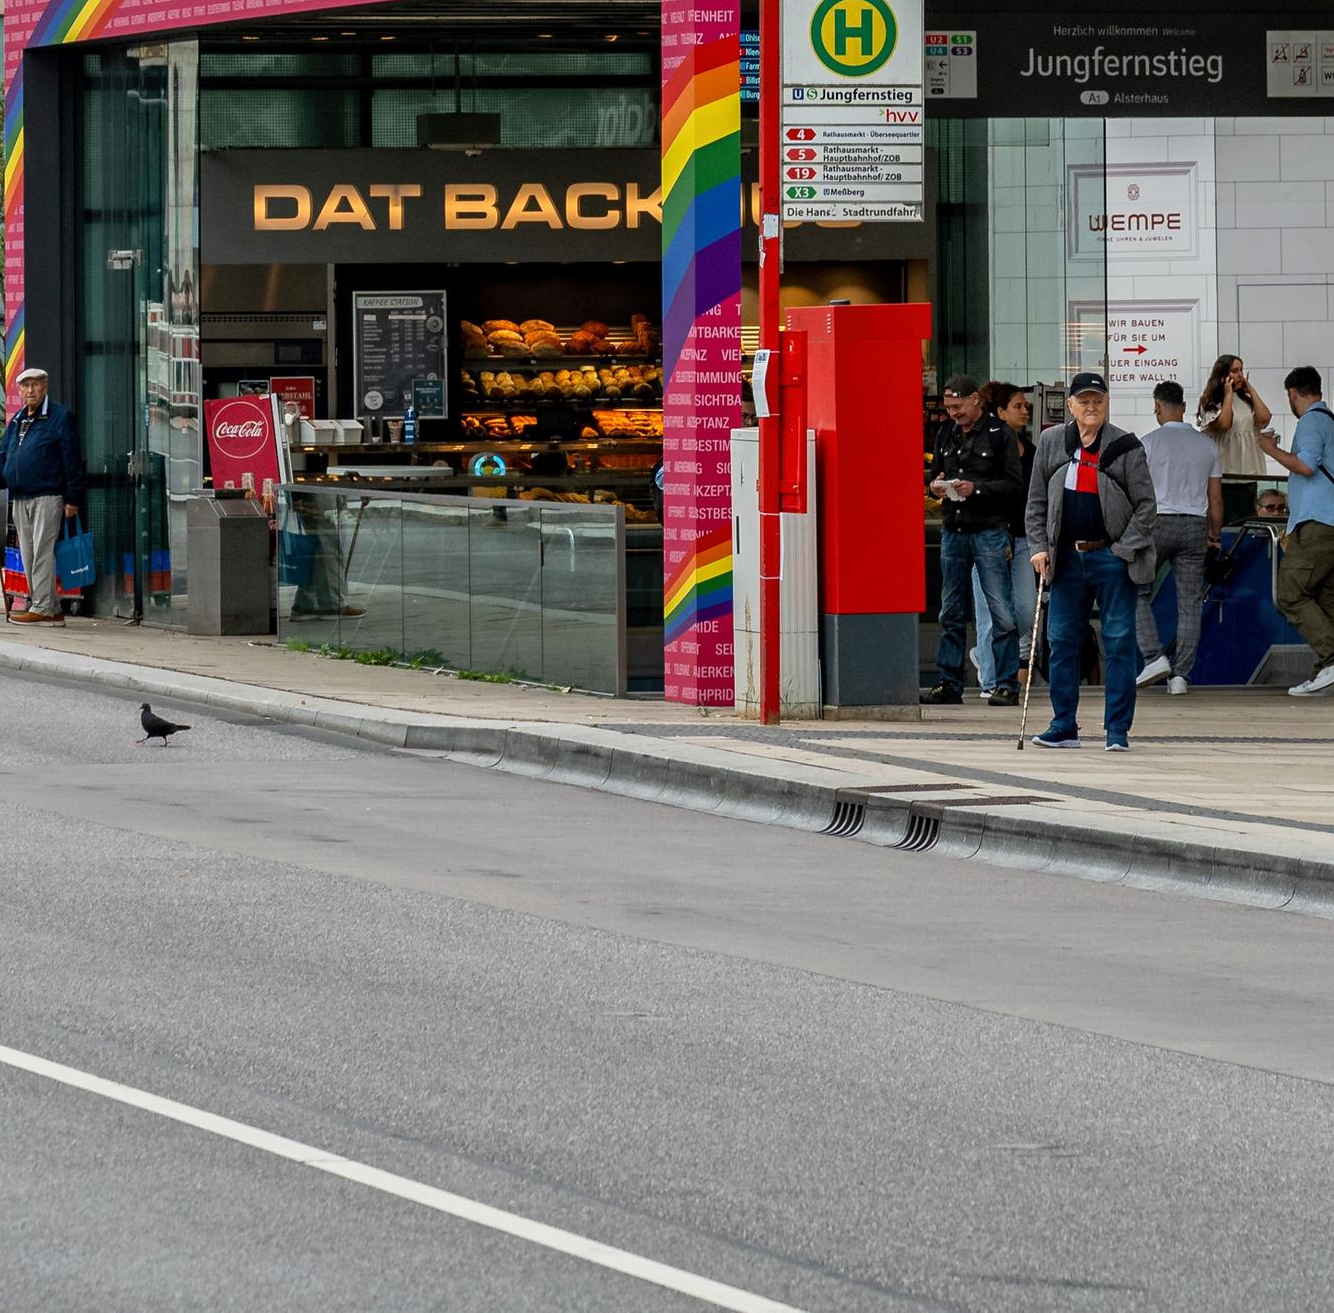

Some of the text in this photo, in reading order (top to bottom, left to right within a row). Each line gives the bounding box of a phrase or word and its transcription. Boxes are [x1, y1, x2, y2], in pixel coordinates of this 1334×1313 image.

[834, 9, 873, 55] H
[1053, 26, 1095, 36] Herzlich
[1097, 26, 1158, 36] willkommen
[1020, 46, 1223, 83] Jungfernstieg
[820, 89, 913, 103] Jungfernstieg
[1088, 93, 1169, 103] A1 Alsterhaus
[886, 109, 919, 122] hvv
[797, 130, 805, 139] 4
[870, 131, 920, 139] Überseequartier
[798, 150, 806, 159] 5
[823, 155, 901, 163] Hauptbahnhof/ZOB
[795, 169, 809, 179] 19
[795, 188, 865, 197] X3 Meßberg
[254, 183, 663, 230] DAT BACK
[788, 208, 804, 217] Die
[1089, 213, 1181, 232] WEMPE
[1109, 319, 1164, 327] WIR BAUEN
[1108, 334, 1127, 342] FÜR
[1135, 359, 1178, 367] EINGANG
[1110, 374, 1135, 382] EUER
[216, 420, 265, 439] Coca-Cola
